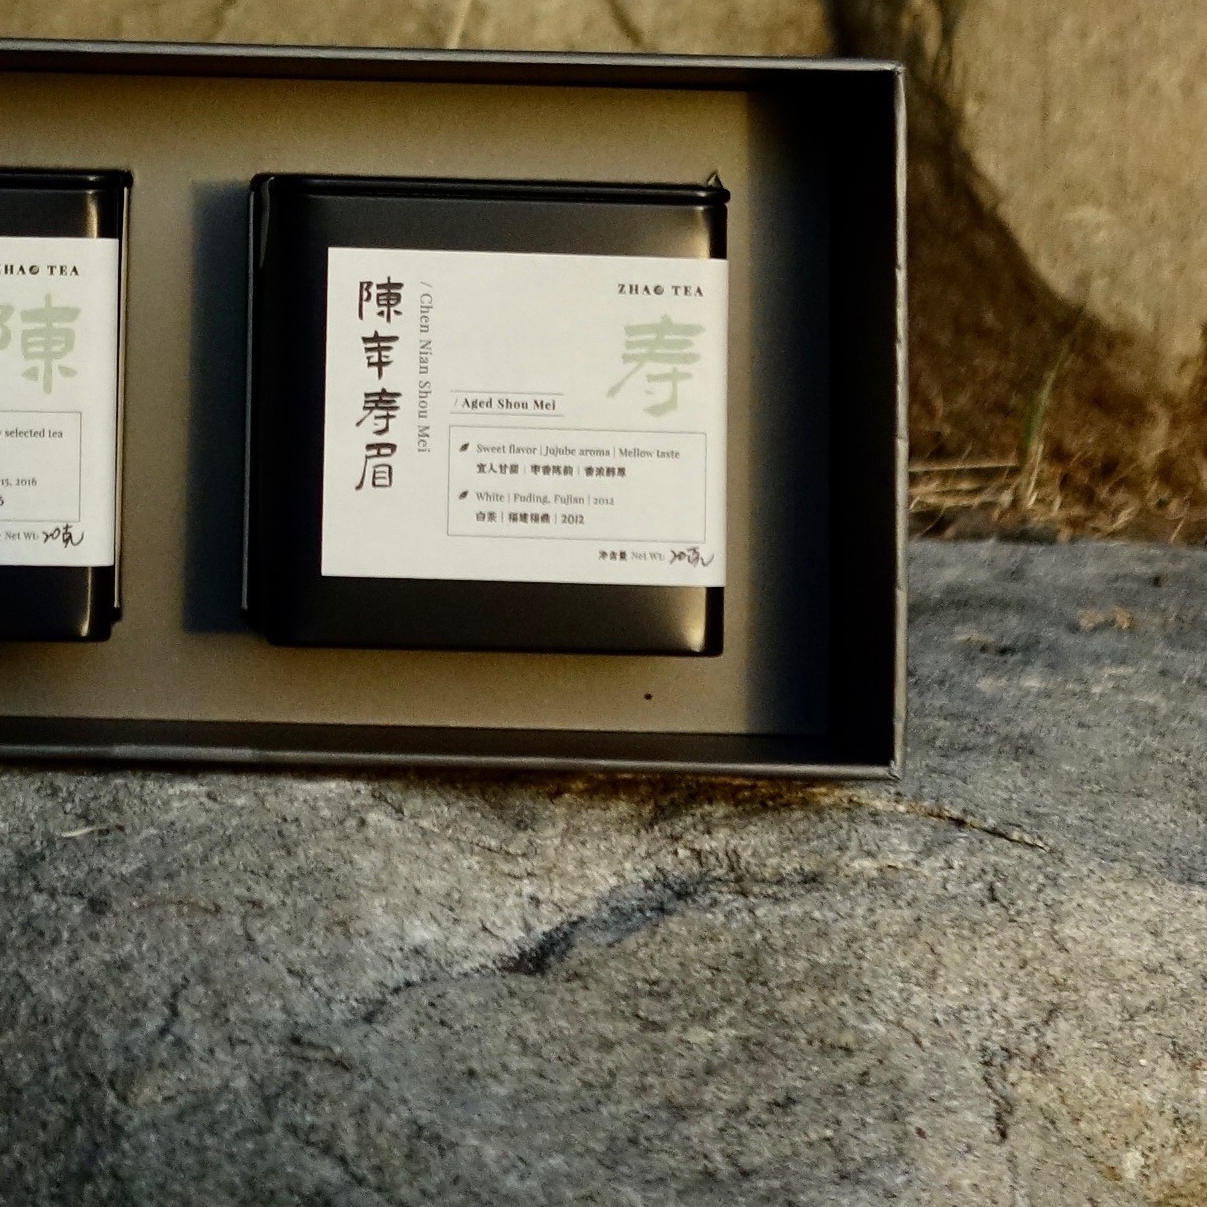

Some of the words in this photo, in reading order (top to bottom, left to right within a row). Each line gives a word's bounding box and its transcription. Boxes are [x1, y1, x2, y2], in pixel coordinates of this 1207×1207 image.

[47, 265, 80, 276] TEA
[618, 283, 665, 296] ZHAO
[672, 285, 705, 297] TEA
[419, 293, 434, 333] Chen
[418, 340, 433, 375] Nian
[417, 381, 432, 419] Shou
[462, 398, 493, 410] Aged
[497, 398, 529, 410] Shou
[533, 399, 556, 411] Mei
[4, 427, 45, 439] selected
[48, 429, 64, 439] tea
[417, 425, 431, 453] Mei
[476, 444, 506, 454] Sweet
[509, 444, 537, 455] flavor
[544, 446, 576, 457] Jujube
[579, 448, 610, 457] aroma
[618, 447, 654, 458] Mellow
[656, 449, 680, 459] taste
[15, 477, 38, 487] 2016
[476, 492, 505, 502] White
[554, 494, 585, 505] Fujian
[593, 497, 615, 506] 2012
[561, 513, 585, 525] 2012
[5, 532, 20, 541] Net
